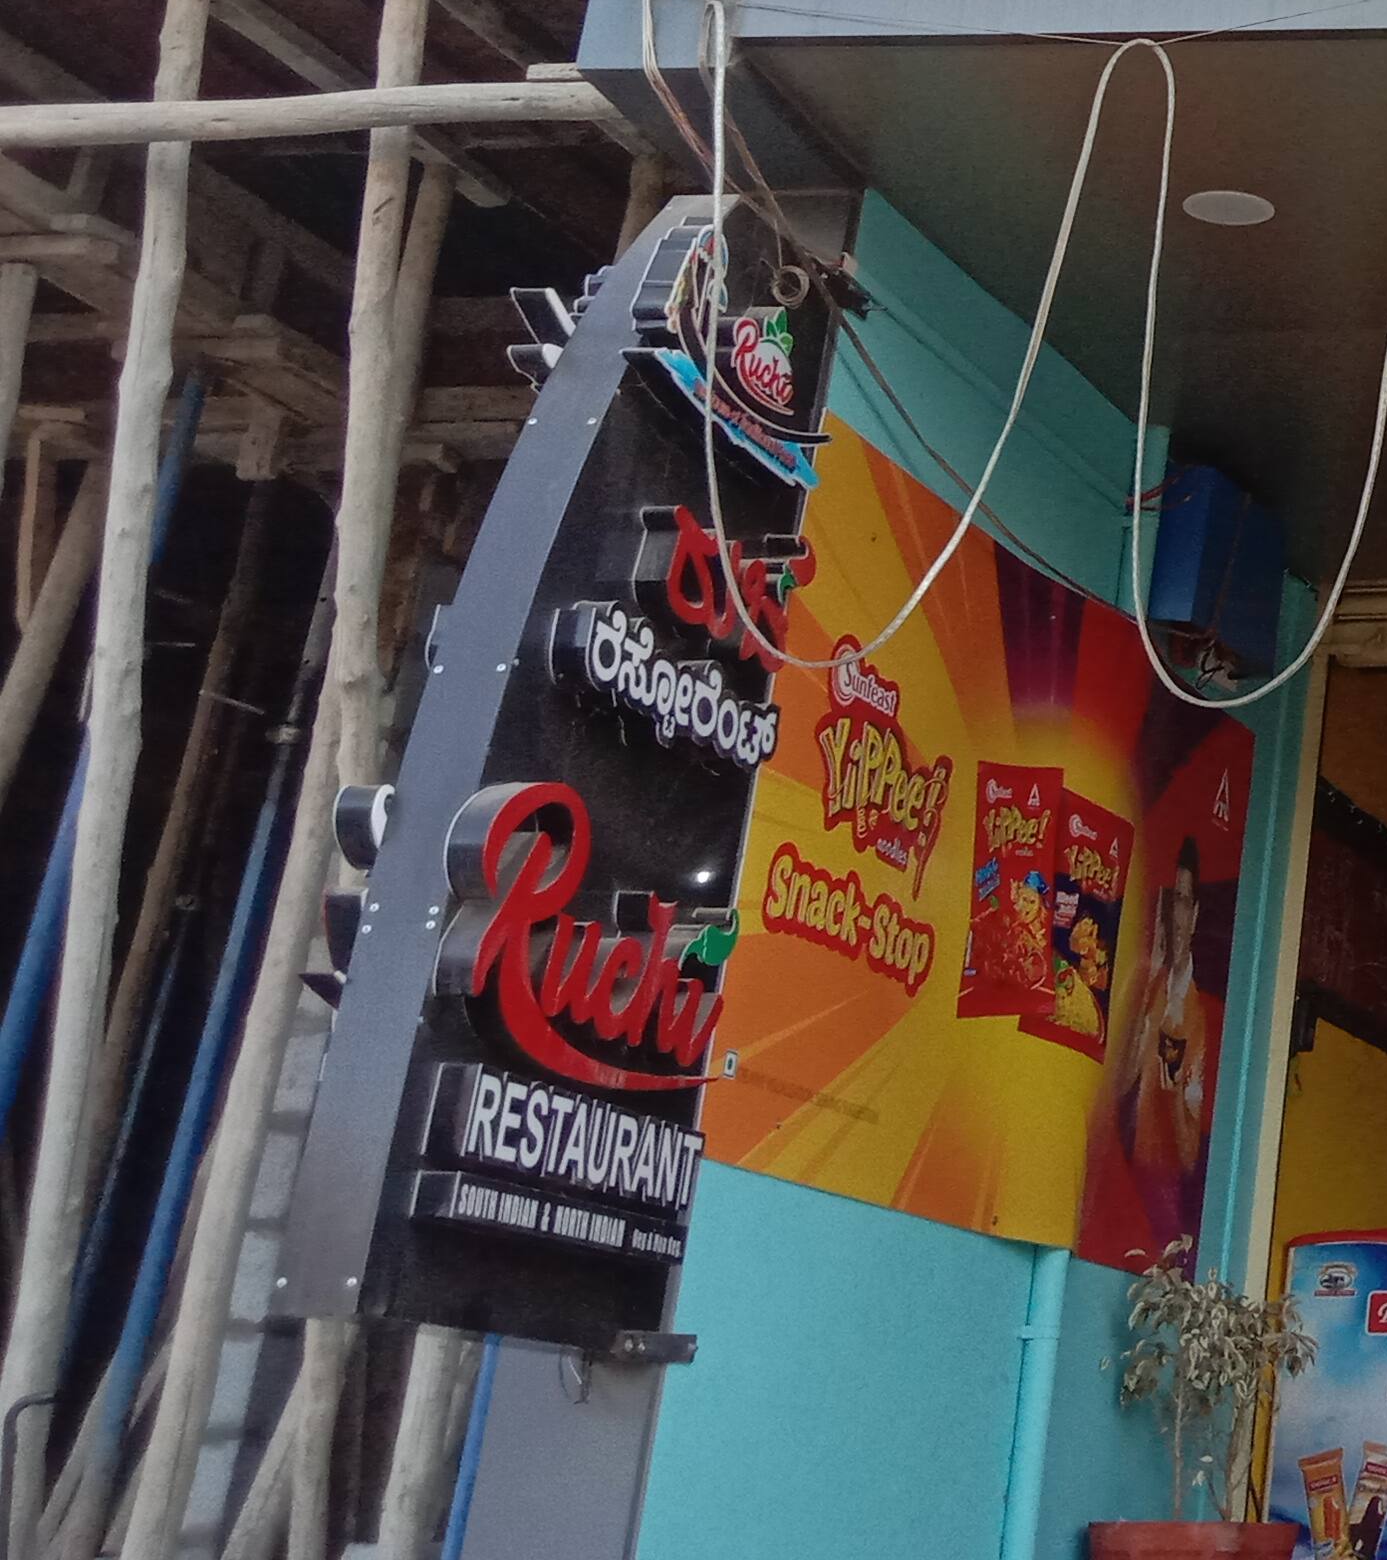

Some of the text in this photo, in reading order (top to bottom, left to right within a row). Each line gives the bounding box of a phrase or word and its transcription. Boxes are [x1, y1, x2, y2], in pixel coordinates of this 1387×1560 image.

[472, 781, 724, 1091] Ruchi
[767, 853, 931, 985] Snack-Stop
[467, 1073, 703, 1206] RESTAURANT
[458, 1184, 499, 1220] SOUTH
[498, 1192, 539, 1229] INDIAN
[540, 1202, 551, 1231] &
[553, 1205, 590, 1240] NORTH
[589, 1213, 626, 1247] INDIAN
